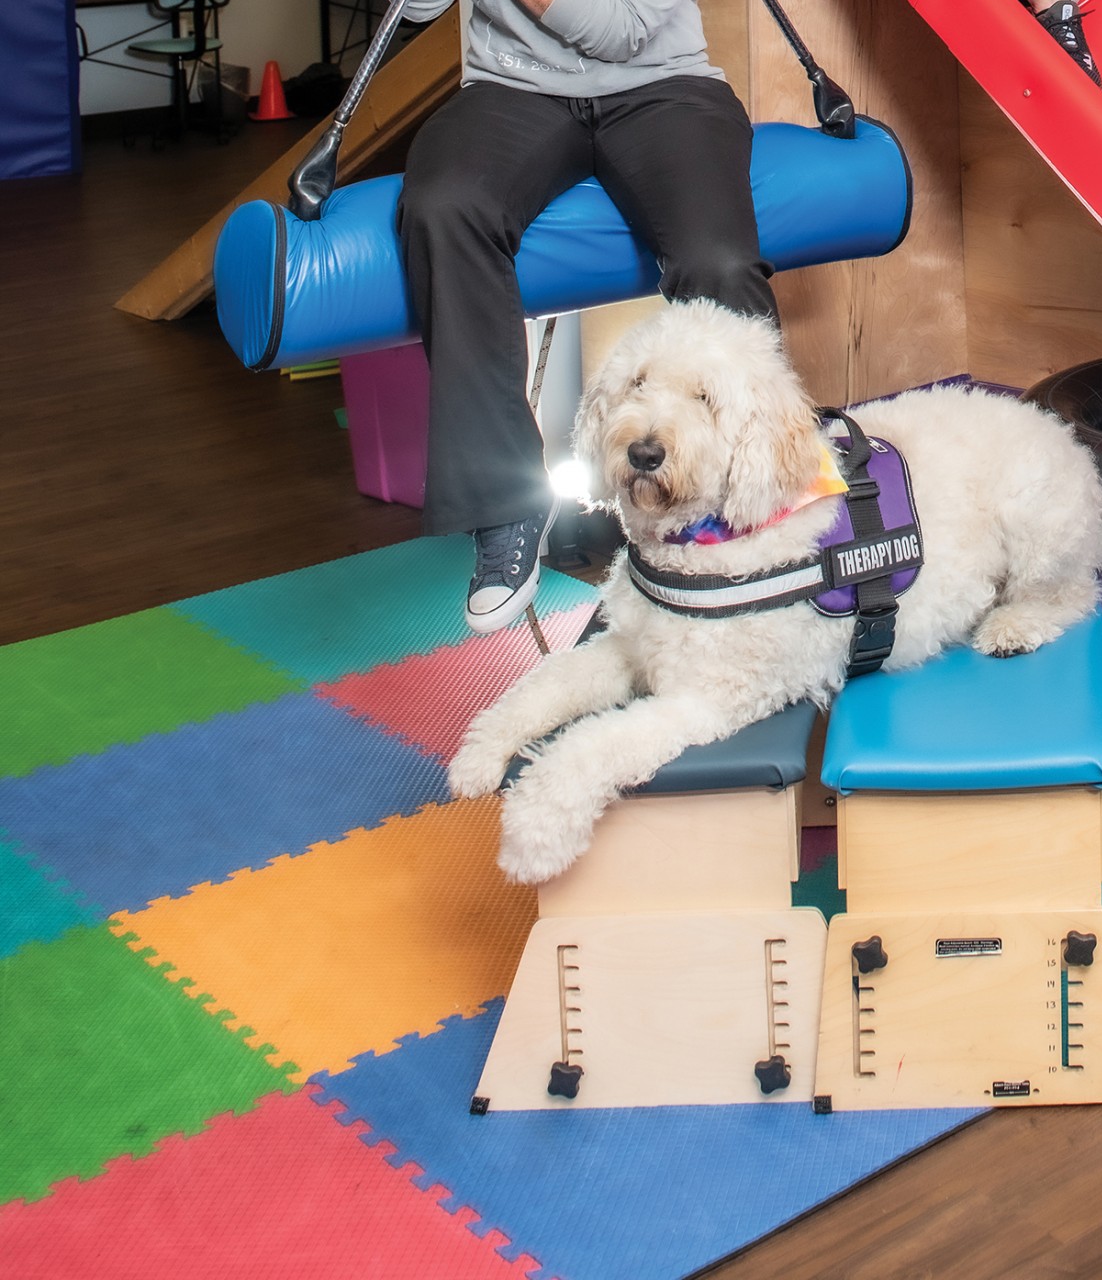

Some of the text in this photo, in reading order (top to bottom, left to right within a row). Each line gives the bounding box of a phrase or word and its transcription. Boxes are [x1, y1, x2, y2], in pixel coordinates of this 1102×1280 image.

[837, 534, 920, 577] THERAPY DOG
[1047, 959, 1056, 967] 15
[1047, 980, 1055, 988] 14
[1046, 1001, 1056, 1009] 13
[1048, 1066, 1057, 1074] 10
